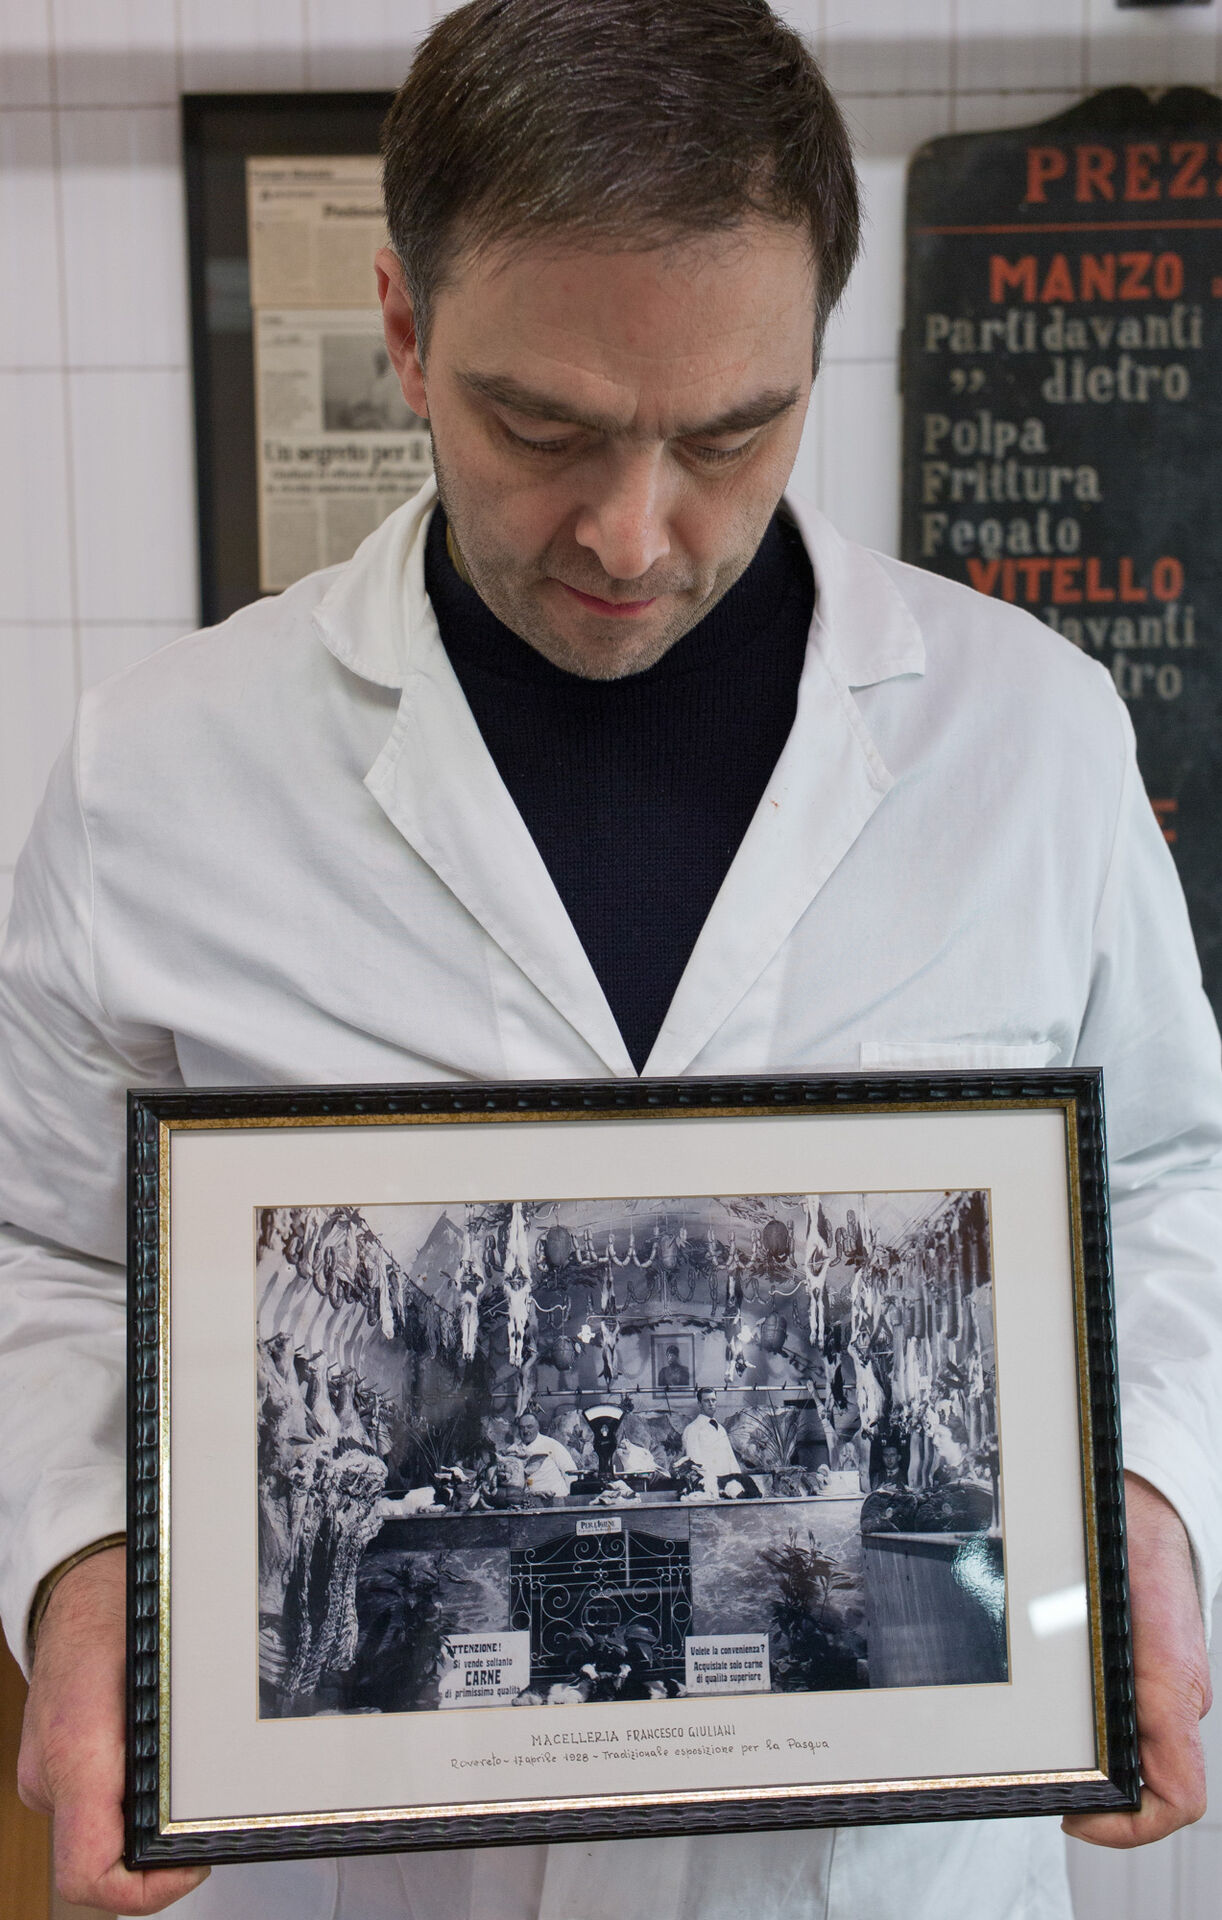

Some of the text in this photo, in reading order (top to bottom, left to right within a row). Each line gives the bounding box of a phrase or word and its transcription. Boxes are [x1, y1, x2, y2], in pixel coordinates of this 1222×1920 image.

[1025, 142, 1222, 203] PREZ
[989, 251, 1184, 303] MANZO
[1042, 353, 1191, 404] dietro
[923, 409, 1048, 459] Polpa
[921, 458, 1101, 505] Frittura
[921, 508, 1082, 561] Fegato
[966, 556, 1184, 604] VITELLO
[453, 1656, 513, 1669] Si vende soltanto
[691, 1646, 710, 1656] Volete
[712, 1645, 718, 1655] la
[465, 1669, 501, 1686] CARNE
[696, 1673, 703, 1683] di
[730, 1672, 761, 1683] superiore
[730, 1660, 742, 1669] solo
[744, 1660, 763, 1669] carne
[445, 1689, 452, 1699] di
[531, 1724, 737, 1747] MACELLERIA FRANCESCO GIULIANI
[564, 1754, 589, 1763] 1928
[602, 1746, 669, 1760] Tradizionale
[674, 1745, 734, 1759] esposizione
[741, 1744, 759, 1756] per
[766, 1738, 781, 1751] la
[786, 1737, 830, 1756] Pasqua
